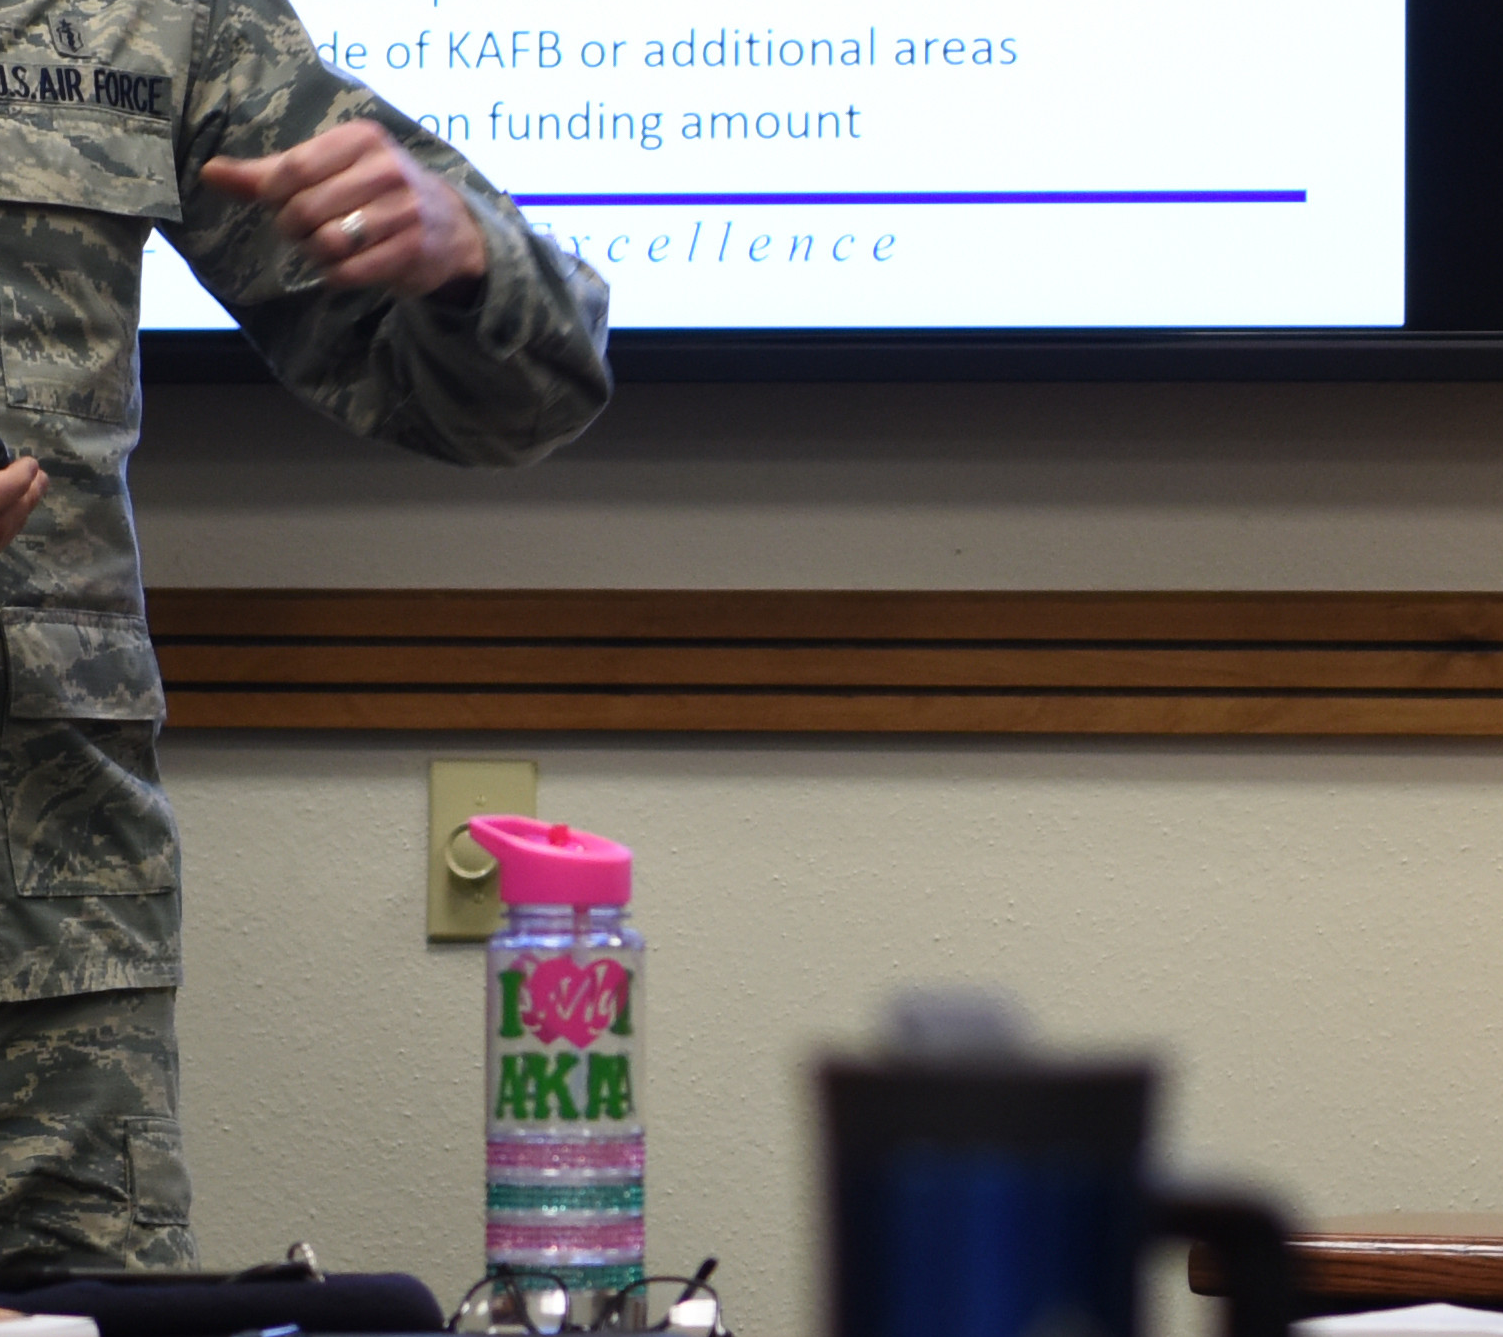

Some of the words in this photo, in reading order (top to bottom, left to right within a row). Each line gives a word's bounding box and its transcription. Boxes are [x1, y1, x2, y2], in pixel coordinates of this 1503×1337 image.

[386, 30, 431, 69] of
[449, 30, 562, 69] KAFB
[581, 41, 627, 68] or
[645, 26, 875, 67] additional
[895, 38, 1018, 65] areas
[93, 69, 164, 113] FORCE
[489, 101, 664, 150] funding
[682, 104, 861, 139] amount
